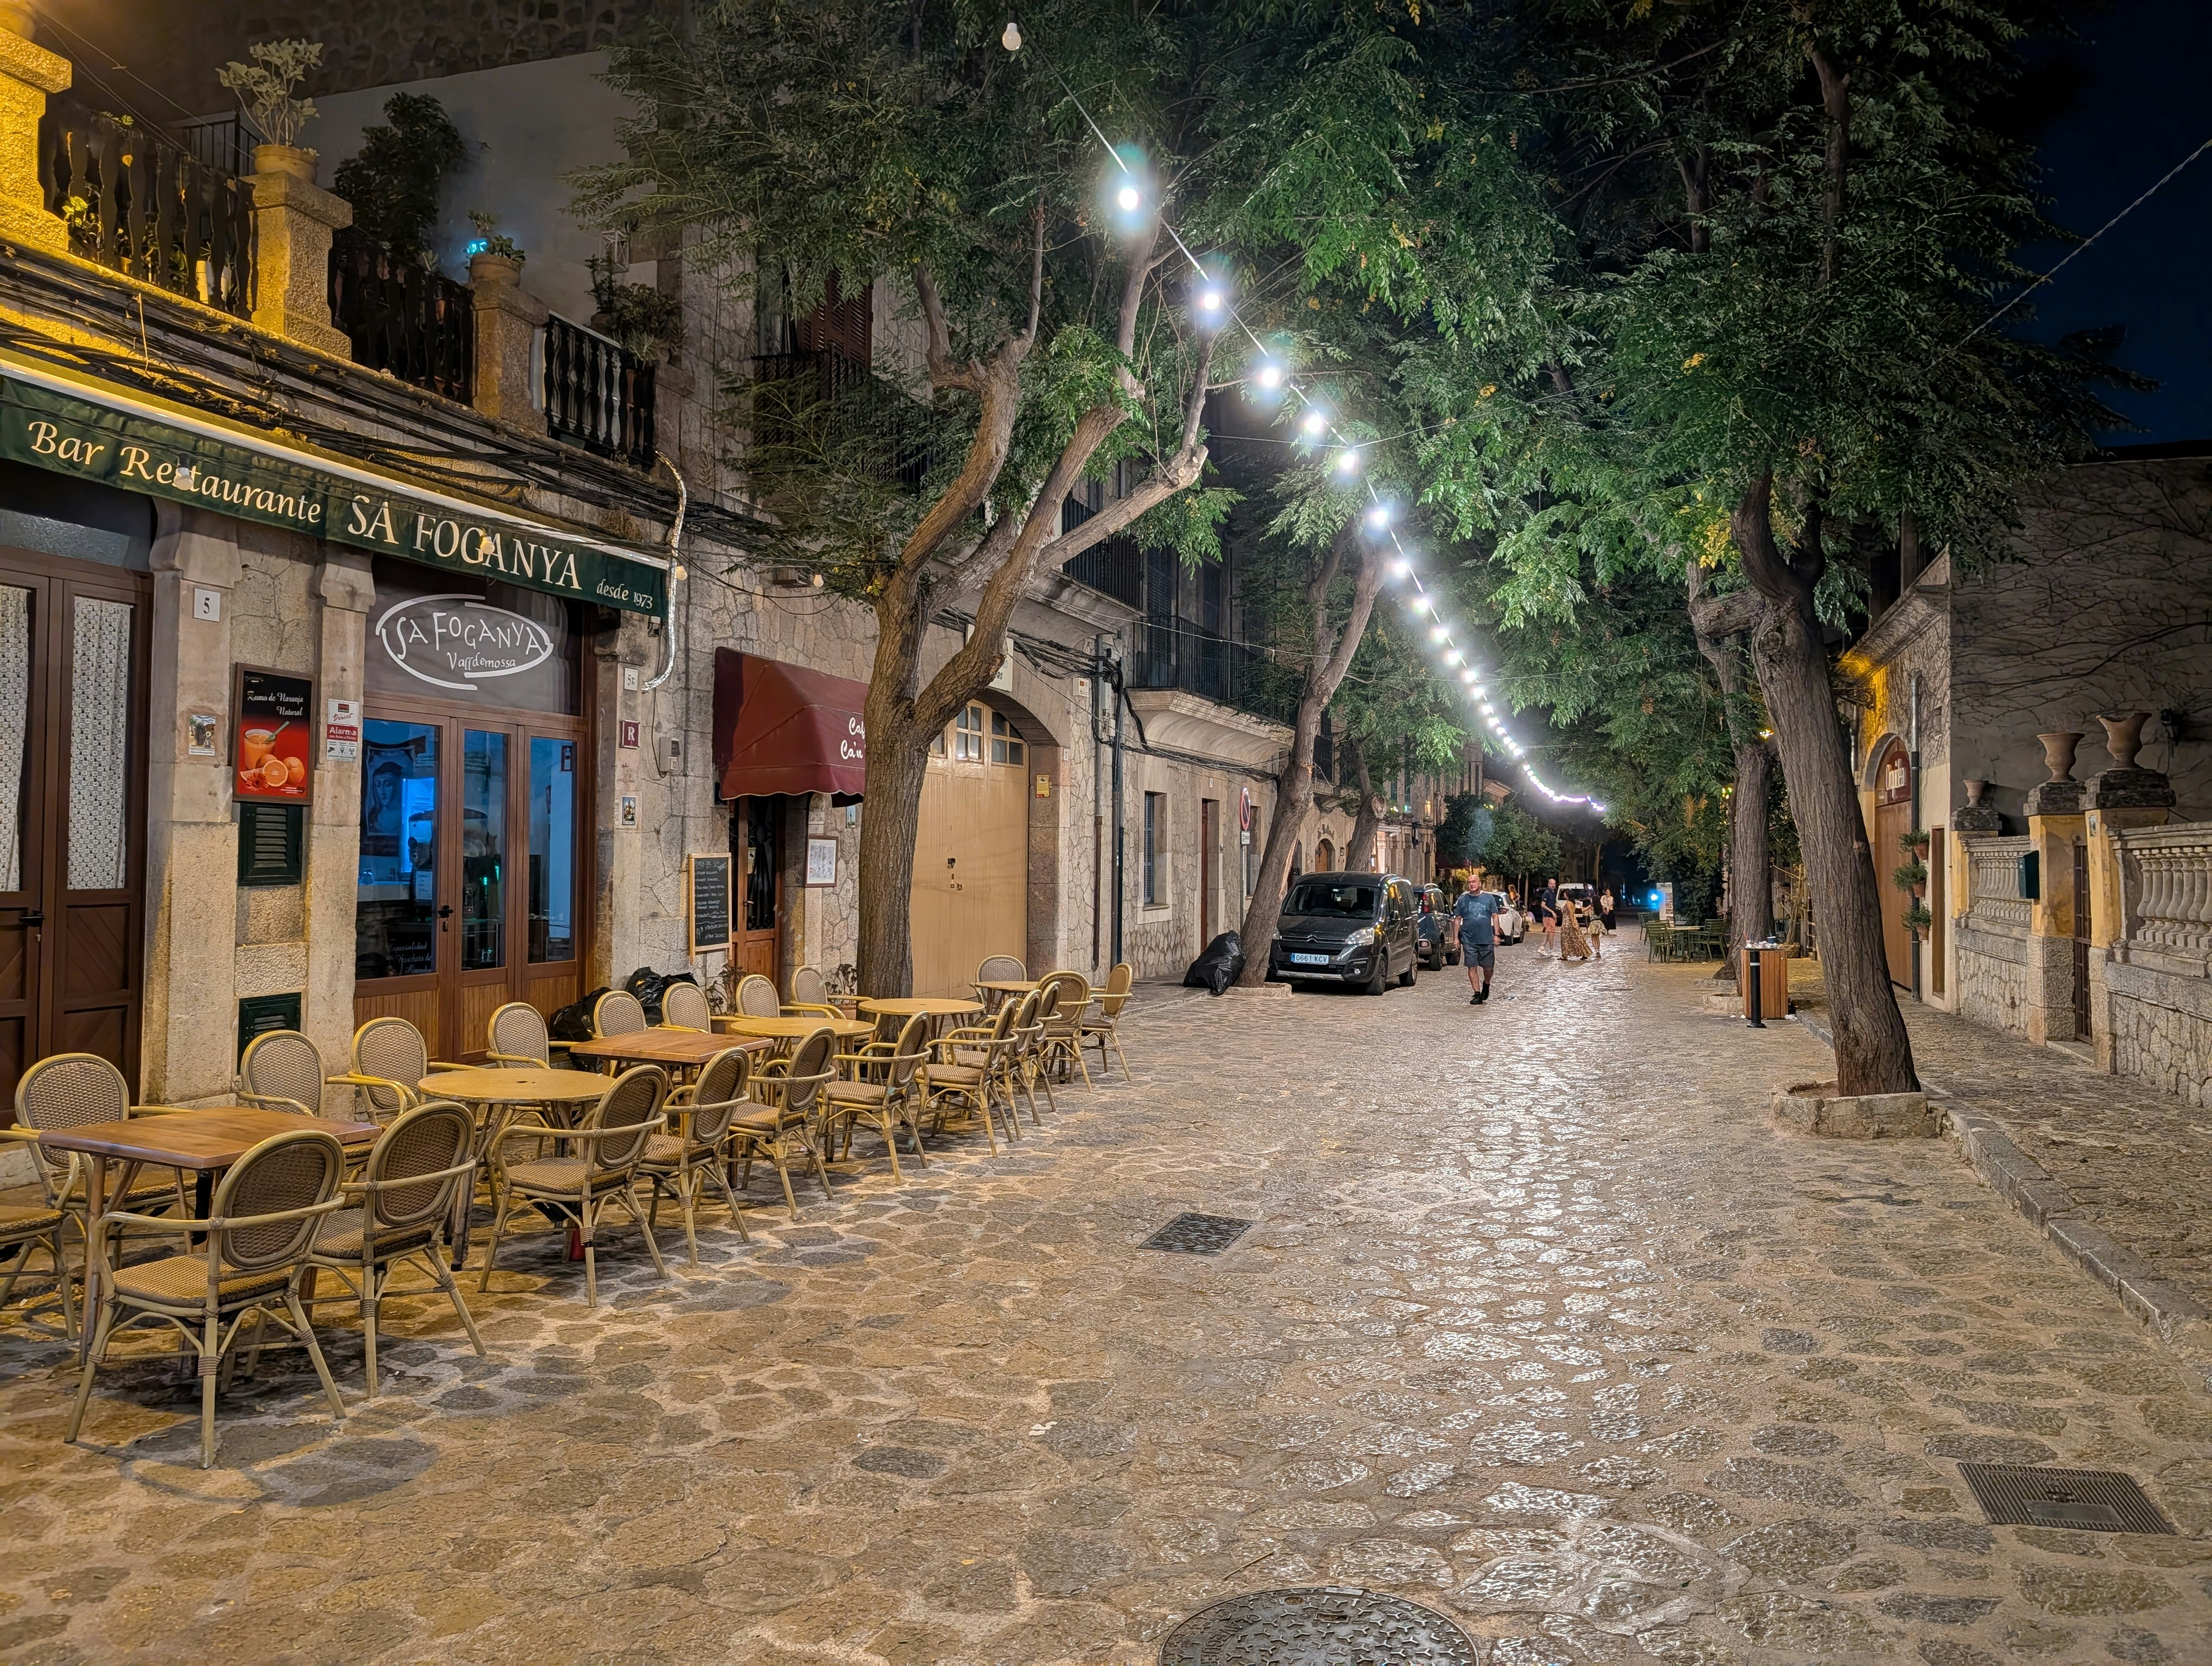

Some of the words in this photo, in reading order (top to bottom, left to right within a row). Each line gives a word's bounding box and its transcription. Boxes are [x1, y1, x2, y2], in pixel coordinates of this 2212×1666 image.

[28, 421, 105, 465] Bar
[348, 495, 399, 544] SA
[412, 514, 582, 590] FOGANYA
[596, 578, 629, 601] desde
[633, 593, 653, 610] 1973
[203, 597, 210, 614] 5
[388, 617, 428, 659] SA
[433, 612, 546, 655] FOGANYA
[446, 652, 516, 671] Valldemossa
[247, 690, 268, 701] Zumo
[268, 693, 276, 702] de
[277, 692, 304, 705] Naranja
[276, 706, 303, 716] Natural
[329, 726, 357, 736] Alarma
[627, 726, 635, 741] R
[848, 717, 866, 740] Caf
